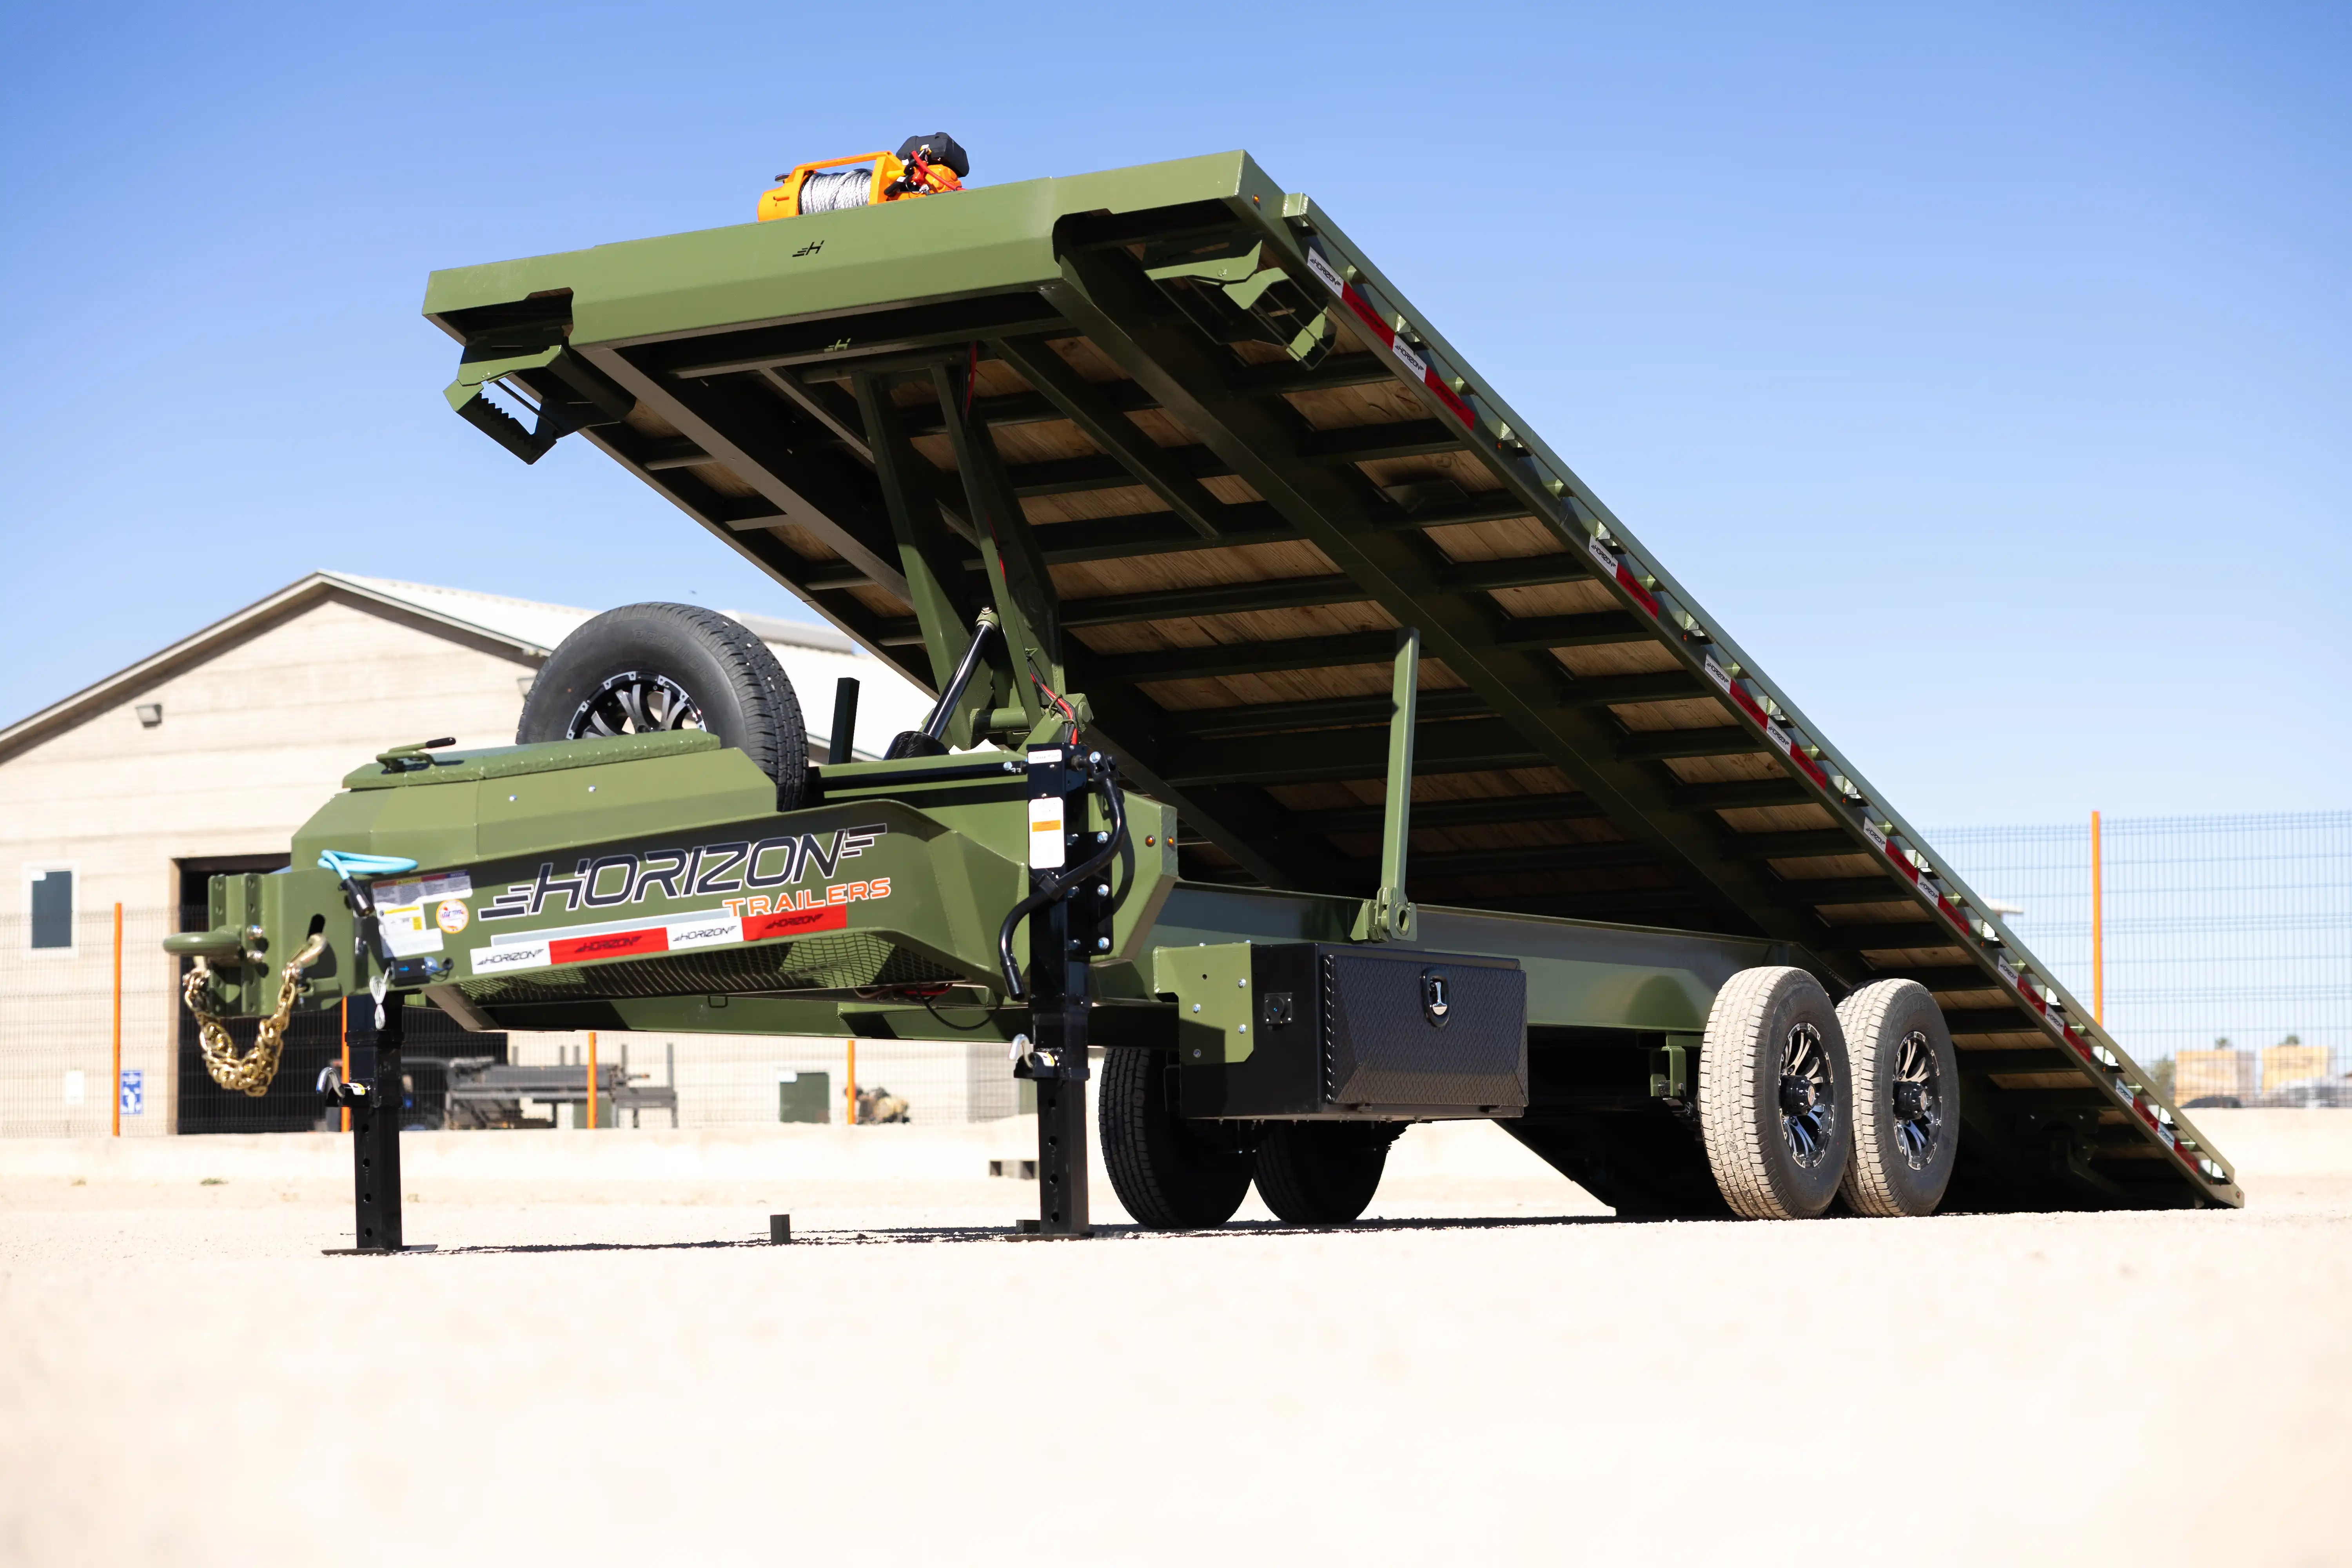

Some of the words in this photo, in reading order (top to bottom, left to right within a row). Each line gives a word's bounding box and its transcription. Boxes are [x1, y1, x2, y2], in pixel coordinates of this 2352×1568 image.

[1313, 258, 1338, 286] HORIZON
[1397, 345, 1421, 371] HORIZON
[1592, 544, 1614, 568] HORIZON
[1708, 662, 1727, 684] HORIZON
[1769, 726, 1788, 746] HORIZON
[1868, 827, 1884, 845] HORIZON
[528, 828, 847, 916] HORIZON
[722, 877, 891, 917] TRAILERS
[483, 951, 538, 965] HORIZON
[581, 937, 635, 953] HORIZON
[679, 927, 730, 941] HORIZON
[772, 915, 817, 929] HORIZON
